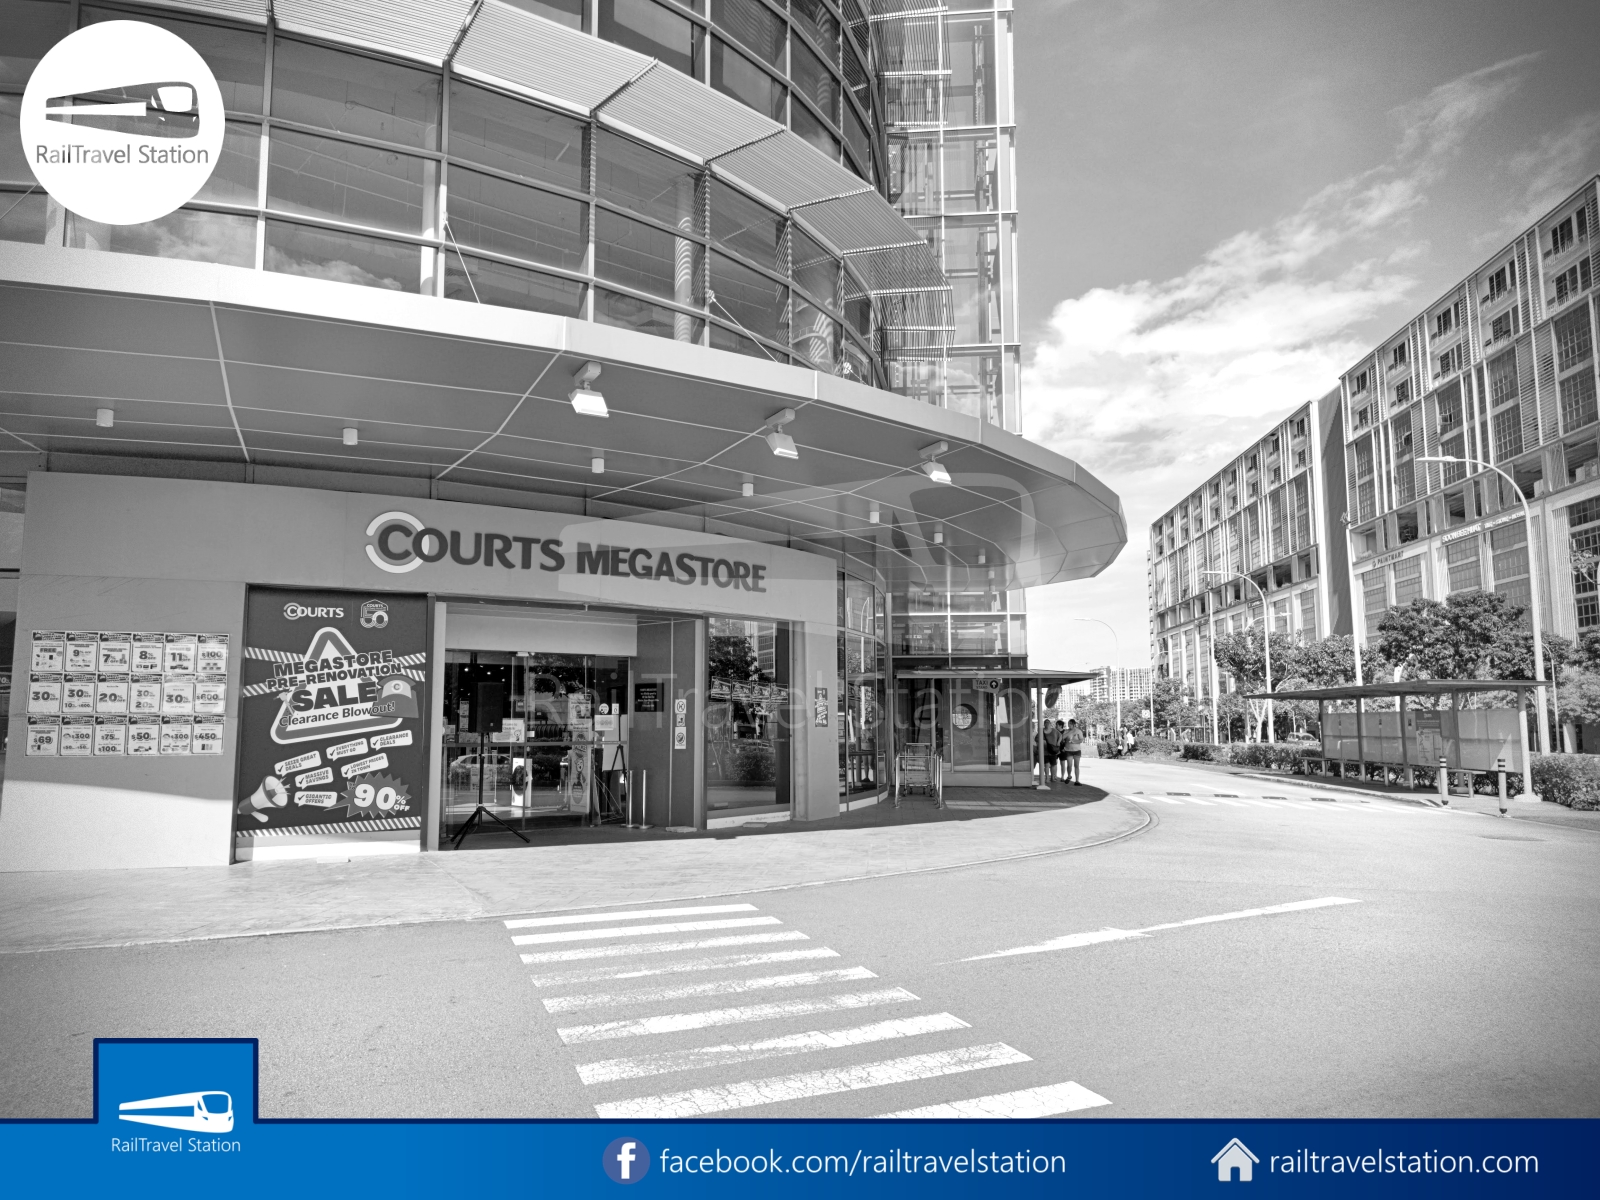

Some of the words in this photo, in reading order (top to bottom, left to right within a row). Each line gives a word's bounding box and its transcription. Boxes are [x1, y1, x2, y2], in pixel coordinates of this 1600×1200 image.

[376, 524, 566, 572] COURTS
[576, 541, 767, 593] MEGASTORE
[285, 604, 345, 620] COURTS
[273, 650, 393, 678] MEGASTORE
[266, 662, 402, 690] PRE-RENOVATION
[291, 681, 378, 712] SALE
[280, 711, 339, 727] Clearance
[342, 701, 396, 718] Blowout!
[380, 732, 409, 742] CLEARANCE
[335, 740, 364, 751] EVERYTHING
[299, 753, 317, 763] GREAT
[285, 762, 303, 772] DEALS
[304, 769, 329, 780] MASSIVE
[305, 775, 330, 785] SAVINGS
[393, 804, 411, 812] OFF
